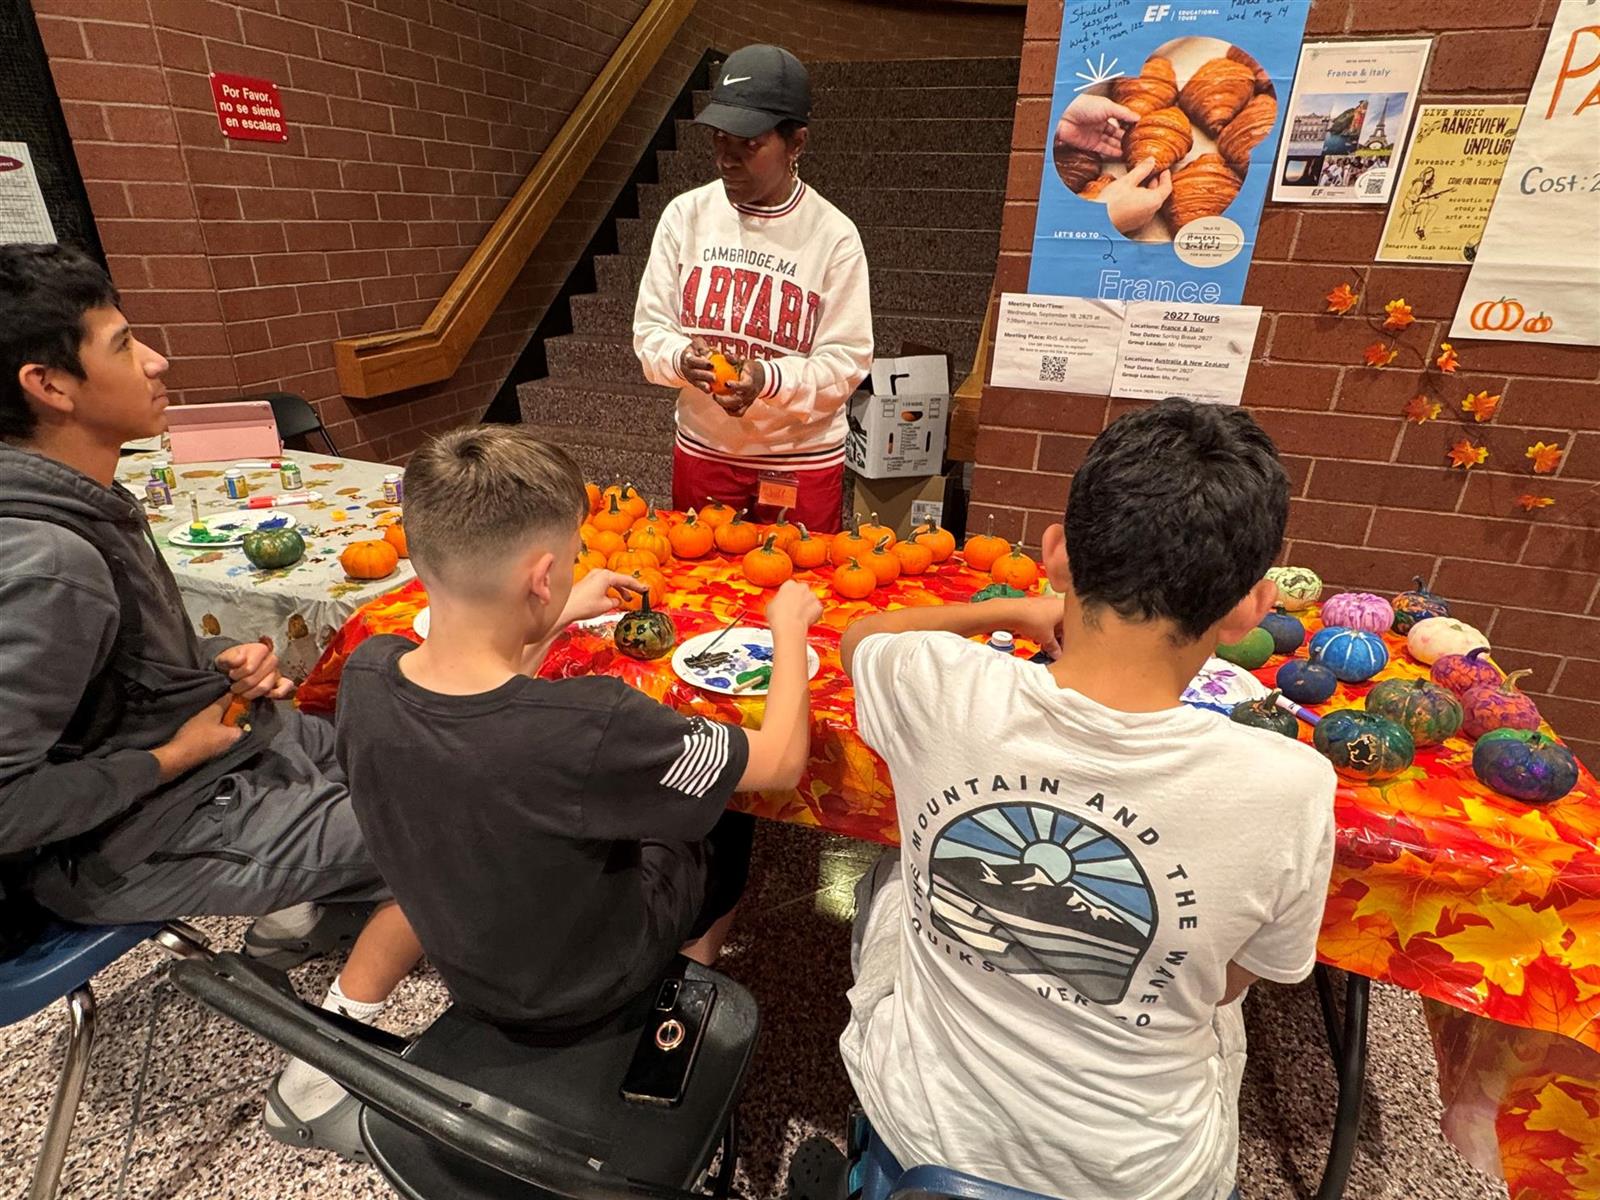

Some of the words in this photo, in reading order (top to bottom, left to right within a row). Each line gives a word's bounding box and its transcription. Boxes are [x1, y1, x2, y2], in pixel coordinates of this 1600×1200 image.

[1143, 4, 1171, 23] EF
[1253, 9, 1273, 24] May
[1278, 5, 1289, 17] 14
[1327, 69, 1358, 78] France
[1360, 68, 1367, 77] &
[1369, 68, 1391, 78] Italy
[222, 84, 240, 98] Por
[242, 87, 272, 105] Favor,
[219, 102, 233, 112] no
[236, 104, 249, 114] se
[251, 104, 281, 118] siente
[1423, 109, 1448, 117] LIVE
[1453, 109, 1485, 117] MUSIC
[225, 117, 239, 128] en
[241, 119, 282, 132] escalara
[1440, 117, 1510, 135] RANGEVIEW
[1463, 138, 1514, 155] UNPLUG
[1054, 231, 1074, 239] LET'S
[1075, 231, 1087, 239] GO
[776, 259, 798, 277] MA
[1098, 269, 1222, 304] France
[1162, 310, 1190, 321] 2027
[1192, 312, 1220, 323] Tours
[1004, 332, 1026, 340] Meeting
[912, 774, 1060, 852] MOUNTAIN
[1086, 792, 1160, 846] AND
[1166, 863, 1198, 930] THE
[911, 917, 1090, 1007] QUIKSVER
[1140, 951, 1188, 1004] WAVE
